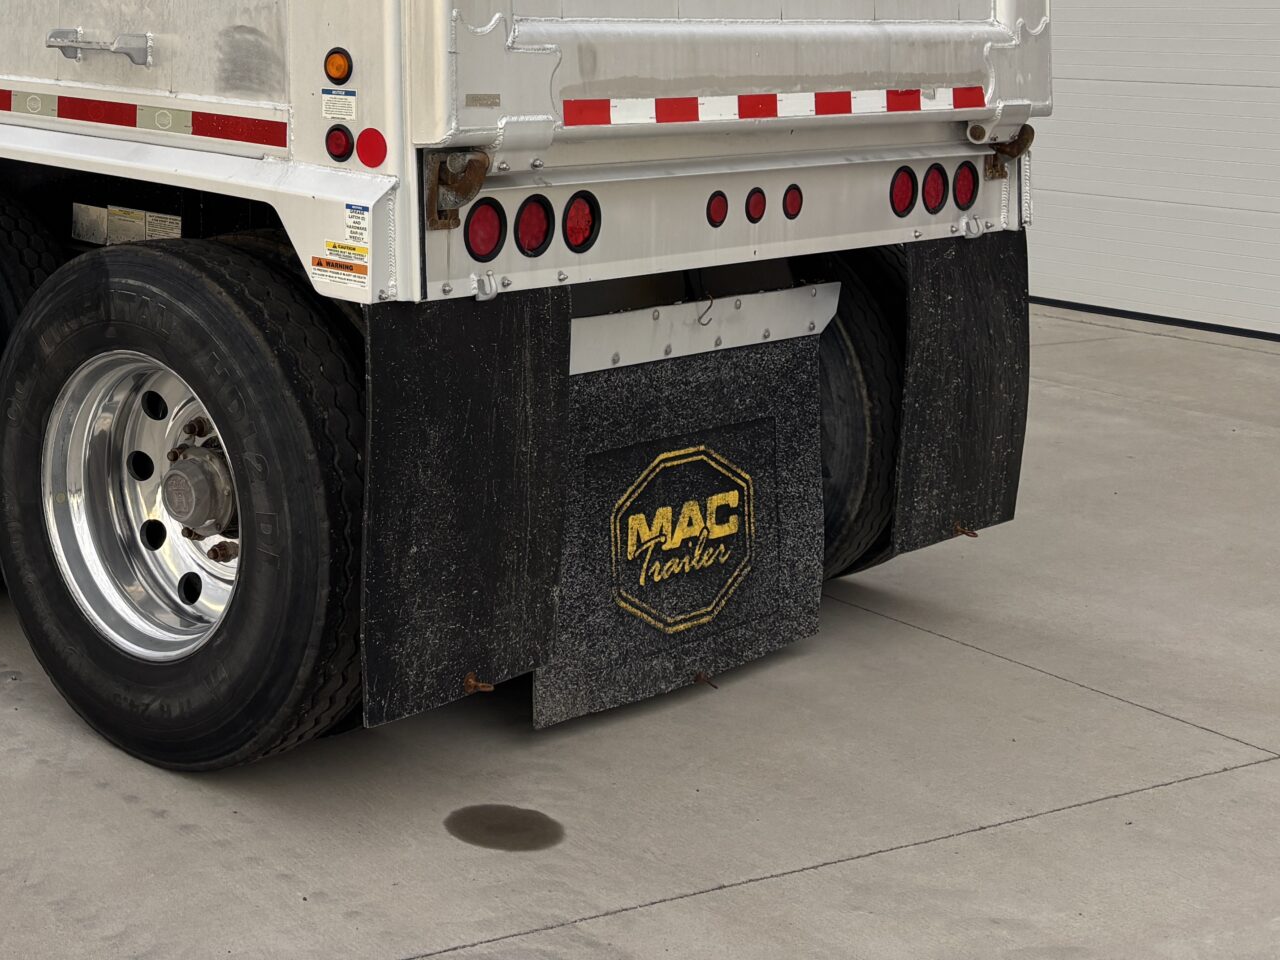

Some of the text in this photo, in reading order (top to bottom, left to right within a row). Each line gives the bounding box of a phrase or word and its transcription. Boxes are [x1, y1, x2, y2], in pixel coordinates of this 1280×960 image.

[326, 261, 353, 271] WARNING
[627, 489, 739, 560] MAC
[634, 526, 731, 586] Trailer
